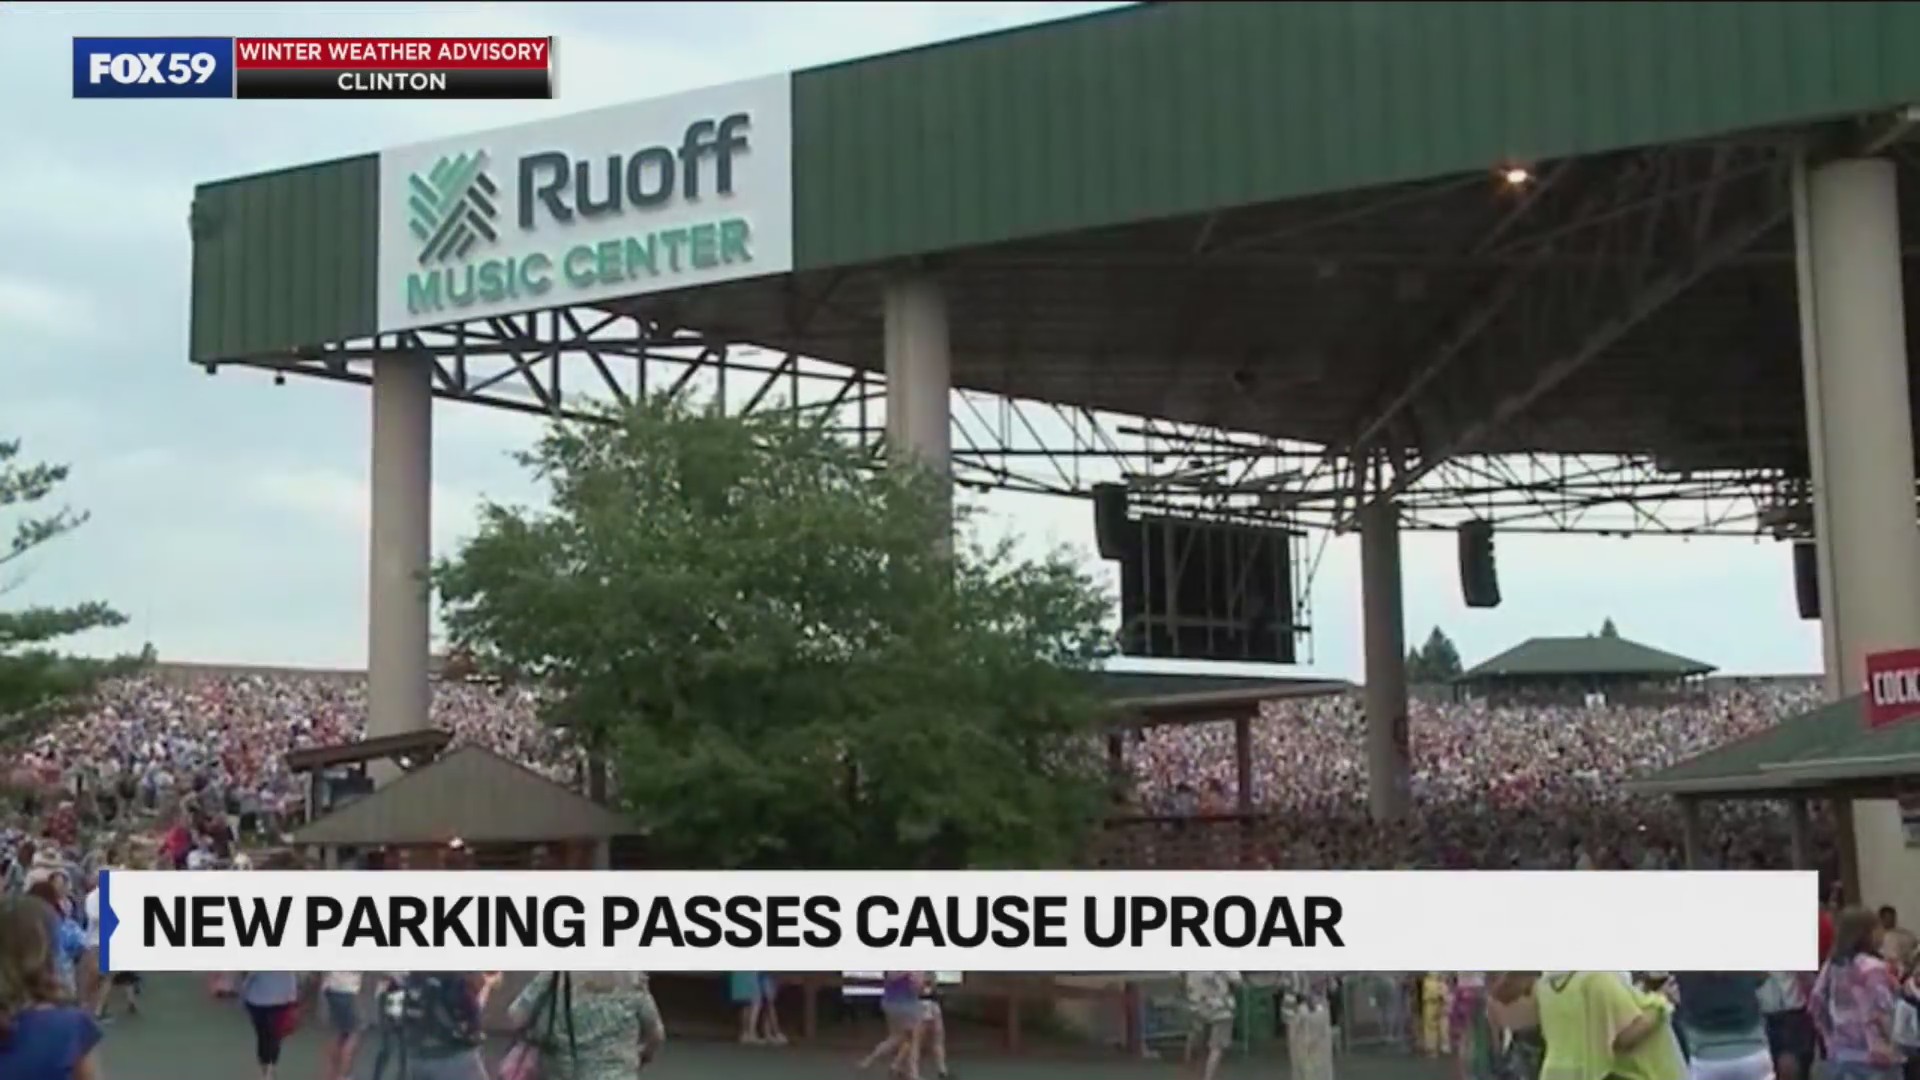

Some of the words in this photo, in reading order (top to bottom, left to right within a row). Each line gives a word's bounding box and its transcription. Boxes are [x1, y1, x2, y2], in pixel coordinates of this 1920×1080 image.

[519, 113, 750, 229] Ruoff
[406, 253, 551, 313] MUSIC
[563, 219, 752, 285] CENTER
